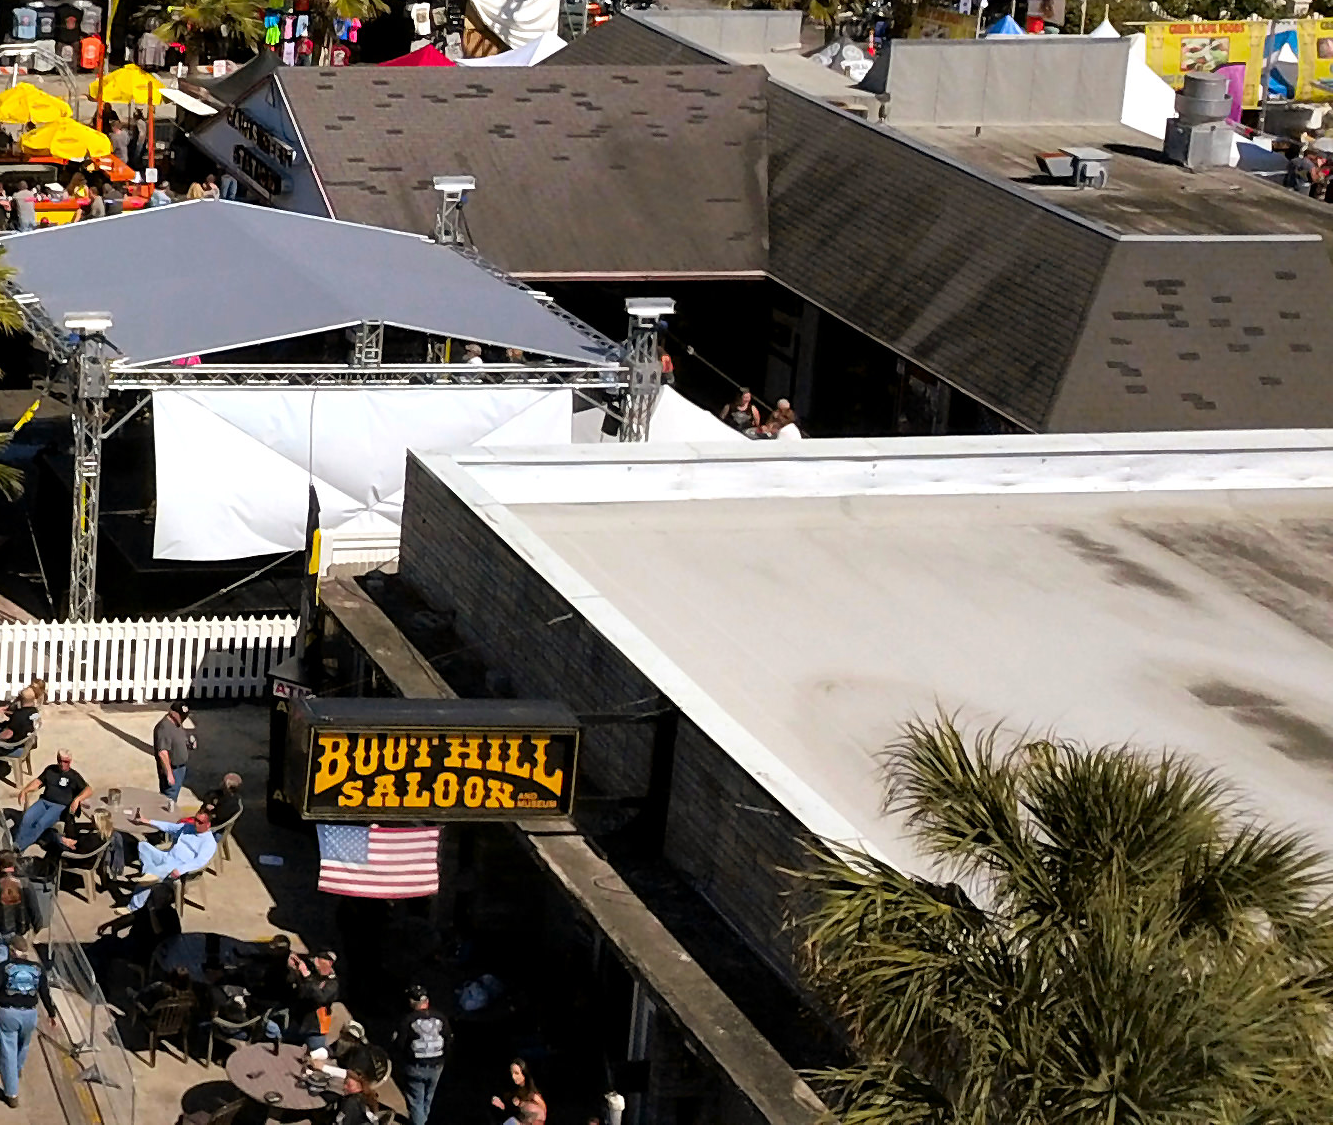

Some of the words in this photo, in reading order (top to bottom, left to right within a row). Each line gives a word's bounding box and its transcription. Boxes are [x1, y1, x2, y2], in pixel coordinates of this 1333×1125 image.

[314, 732, 439, 796] BOOT
[443, 732, 563, 798] HILL
[337, 771, 516, 809] SALOON
